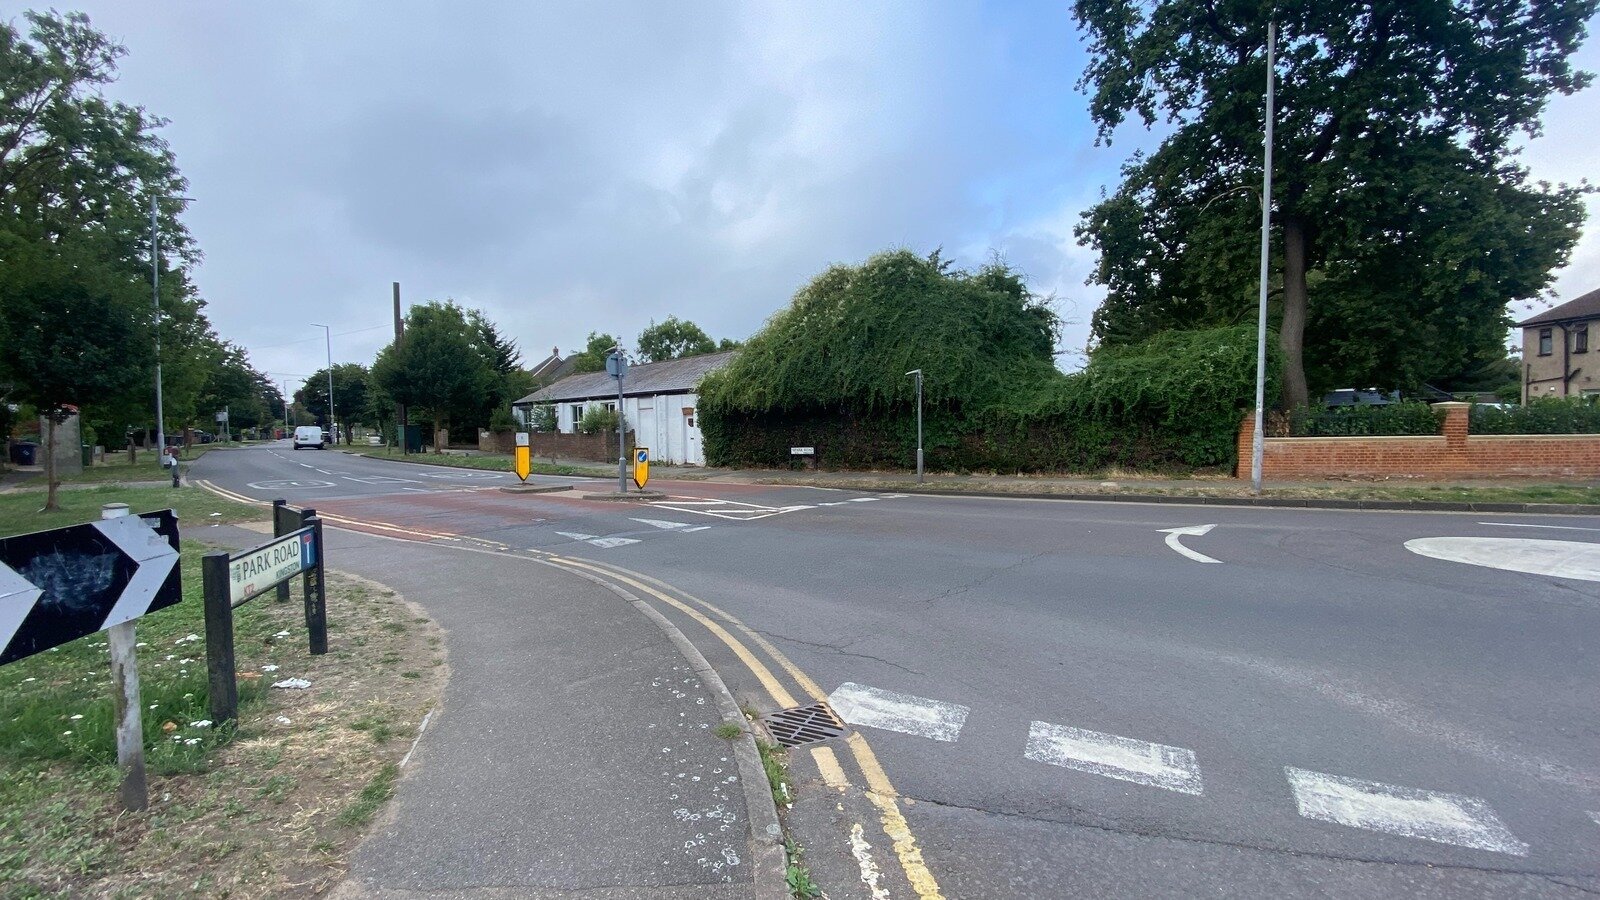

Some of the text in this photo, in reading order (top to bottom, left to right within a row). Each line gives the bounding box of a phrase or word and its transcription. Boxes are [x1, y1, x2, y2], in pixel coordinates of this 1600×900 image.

[243, 541, 299, 580] PARK ROAD
[276, 562, 299, 578] KINGSTON
